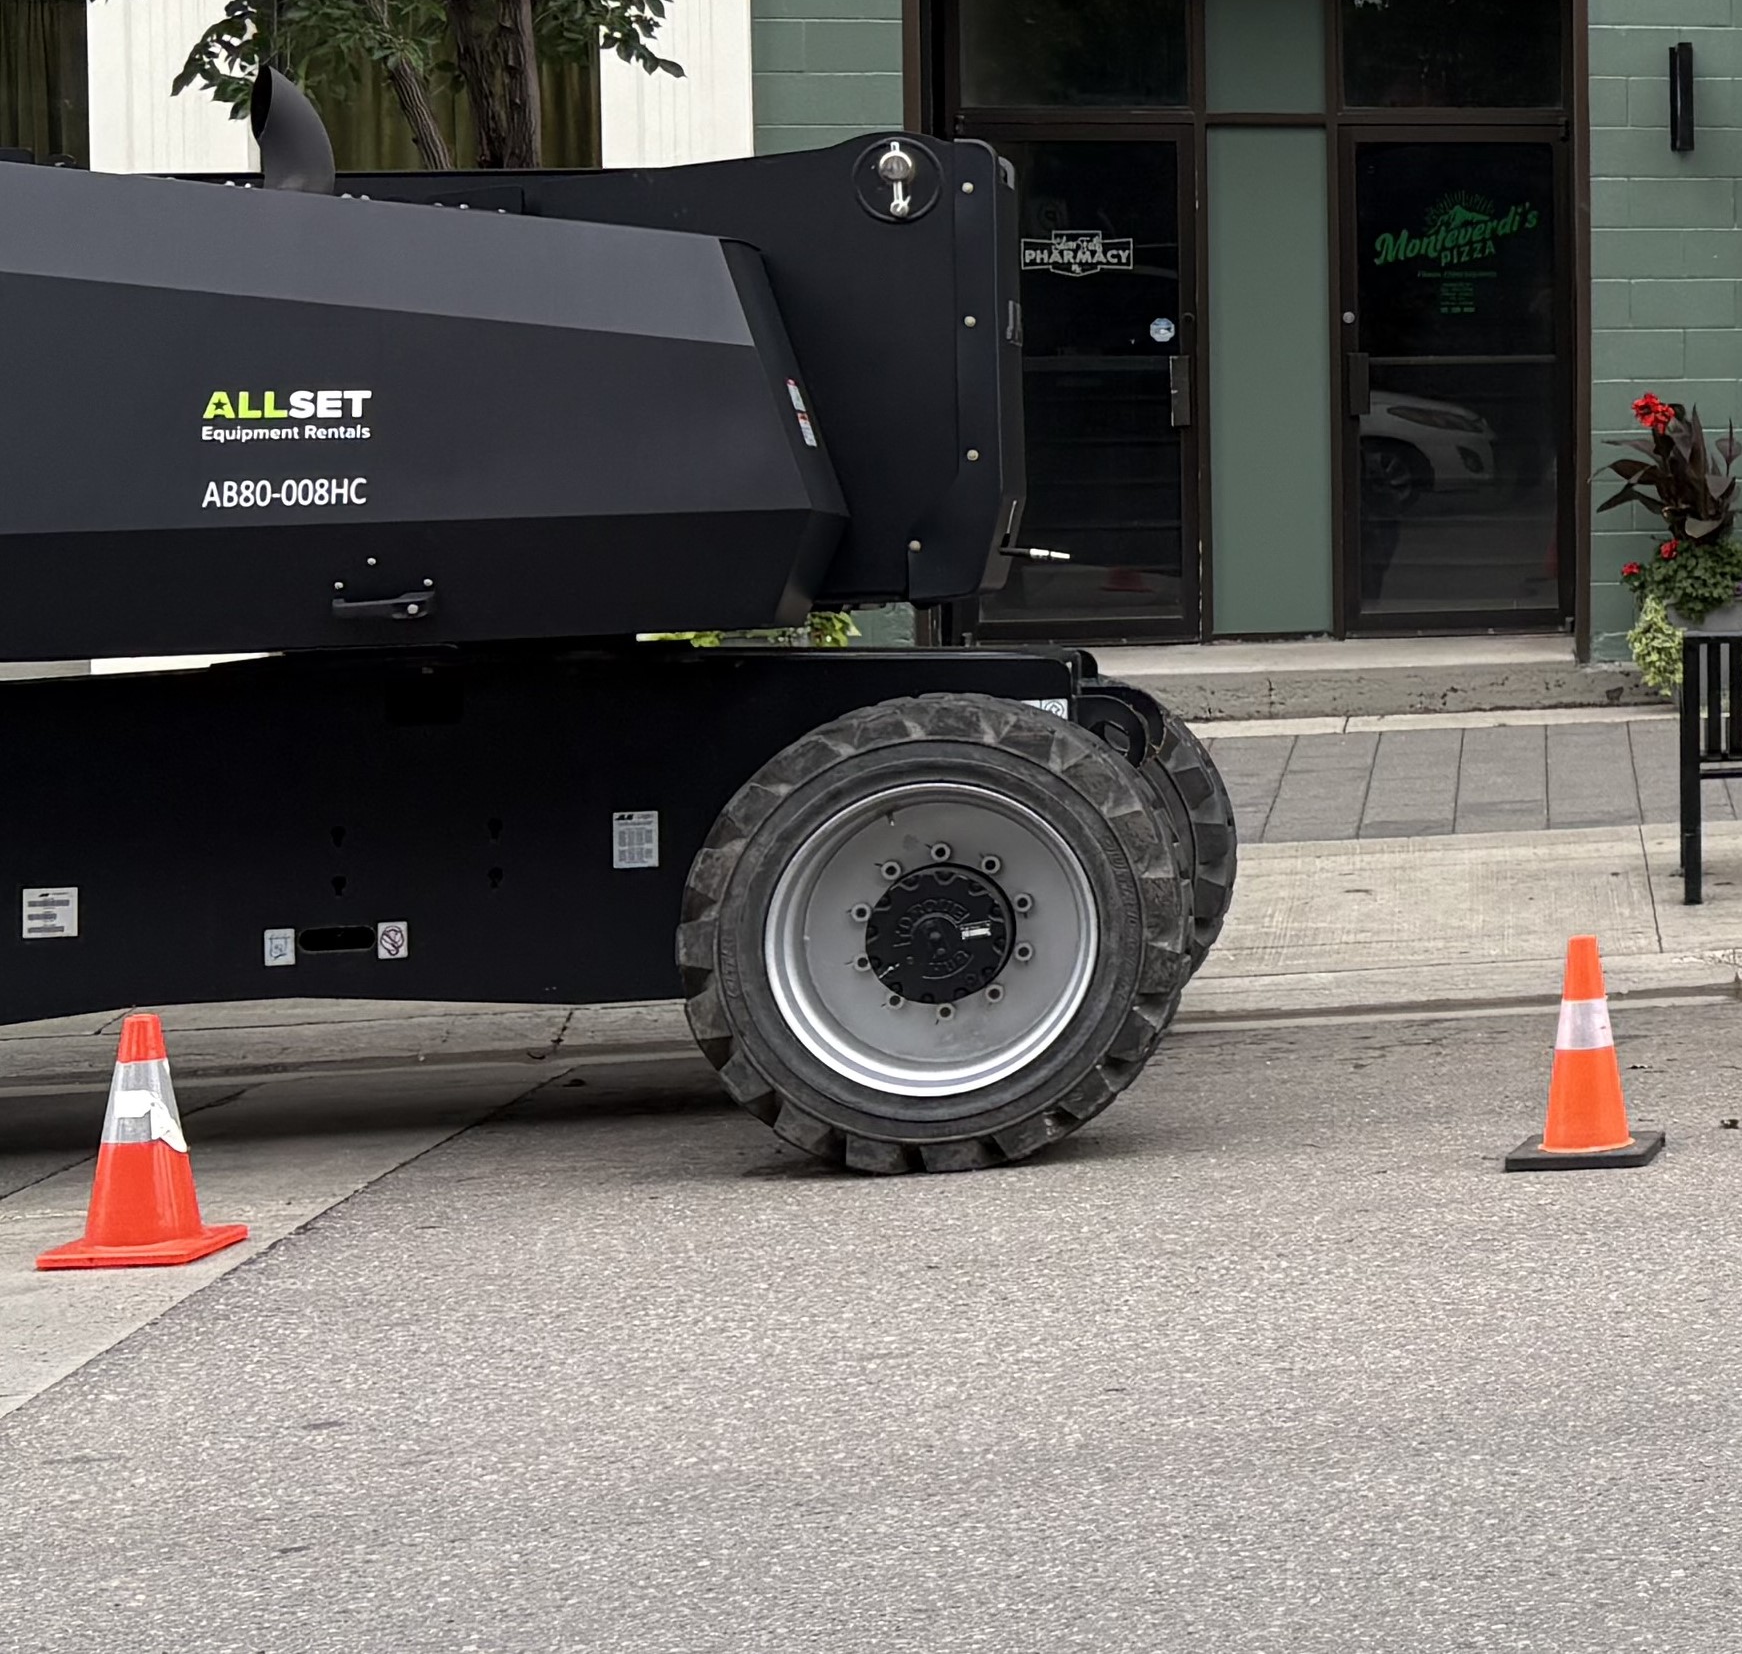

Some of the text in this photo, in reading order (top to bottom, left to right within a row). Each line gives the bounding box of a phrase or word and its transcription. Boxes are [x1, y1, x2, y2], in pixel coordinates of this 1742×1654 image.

[1373, 201, 1540, 266] Monteverdi's
[1024, 249, 1130, 264] PHARMACY
[1440, 239, 1496, 267] PIZZA
[202, 390, 373, 419] ALLSET
[201, 424, 372, 444] Equipment Rentals
[202, 477, 368, 509] AB80-008HC
